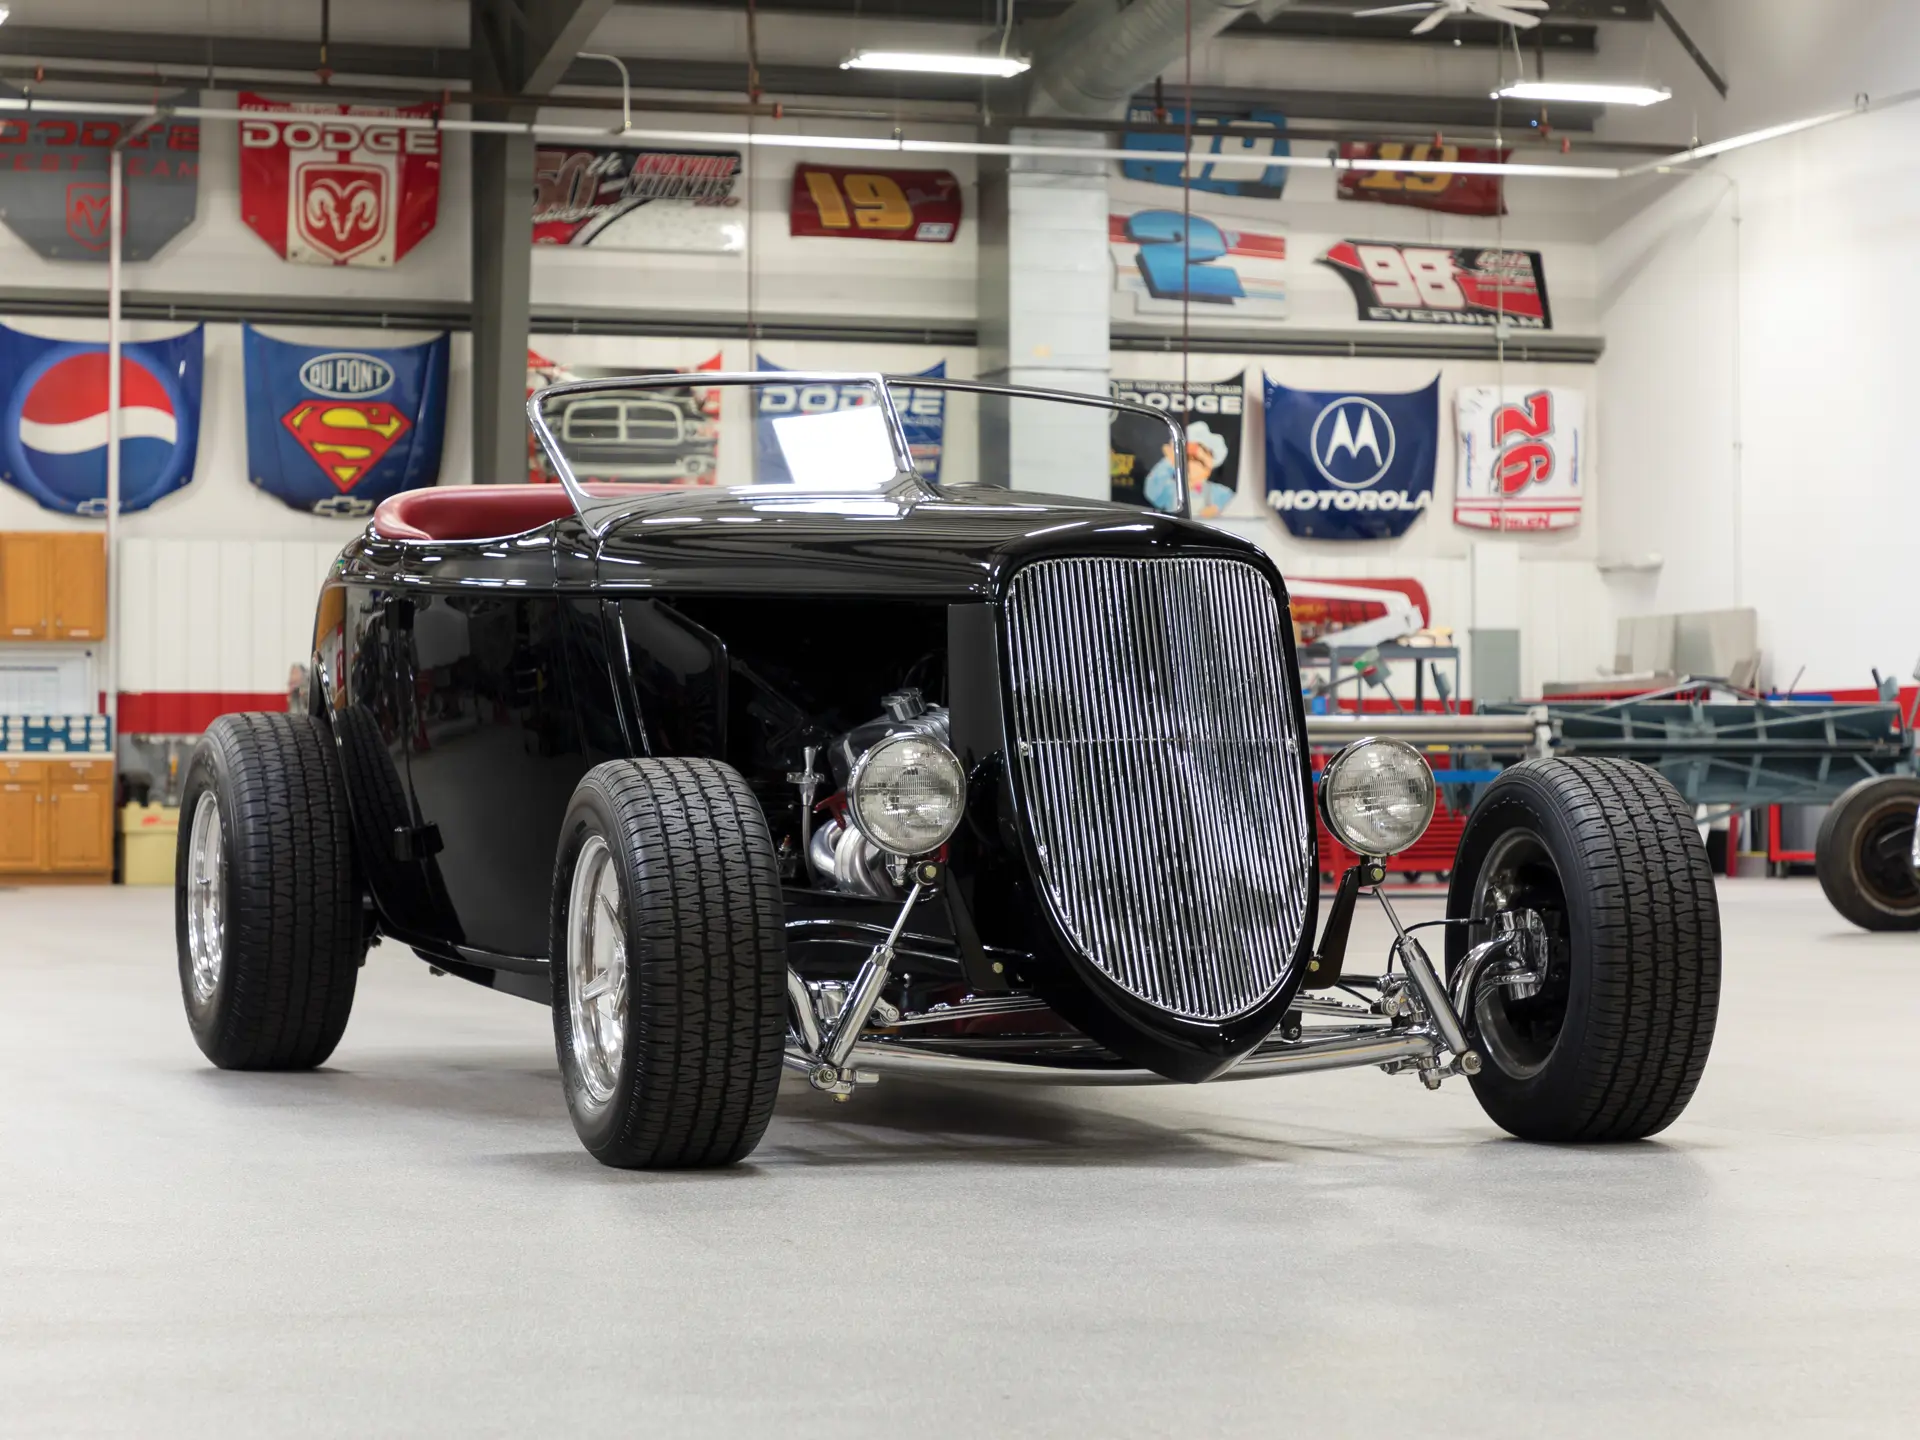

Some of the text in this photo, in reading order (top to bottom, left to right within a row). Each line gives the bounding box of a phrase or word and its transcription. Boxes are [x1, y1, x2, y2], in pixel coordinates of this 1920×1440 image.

[242, 121, 440, 155] DODGE
[631, 153, 740, 178] KNOXVILLE
[1358, 142, 1459, 193] 19
[621, 174, 736, 199] NATIONALS
[804, 171, 914, 229] 19
[1123, 209, 1247, 305] 2
[1356, 245, 1466, 311] 98
[1368, 307, 1544, 328] EVERNHAM
[1266, 489, 1433, 511] MOTOROLA
